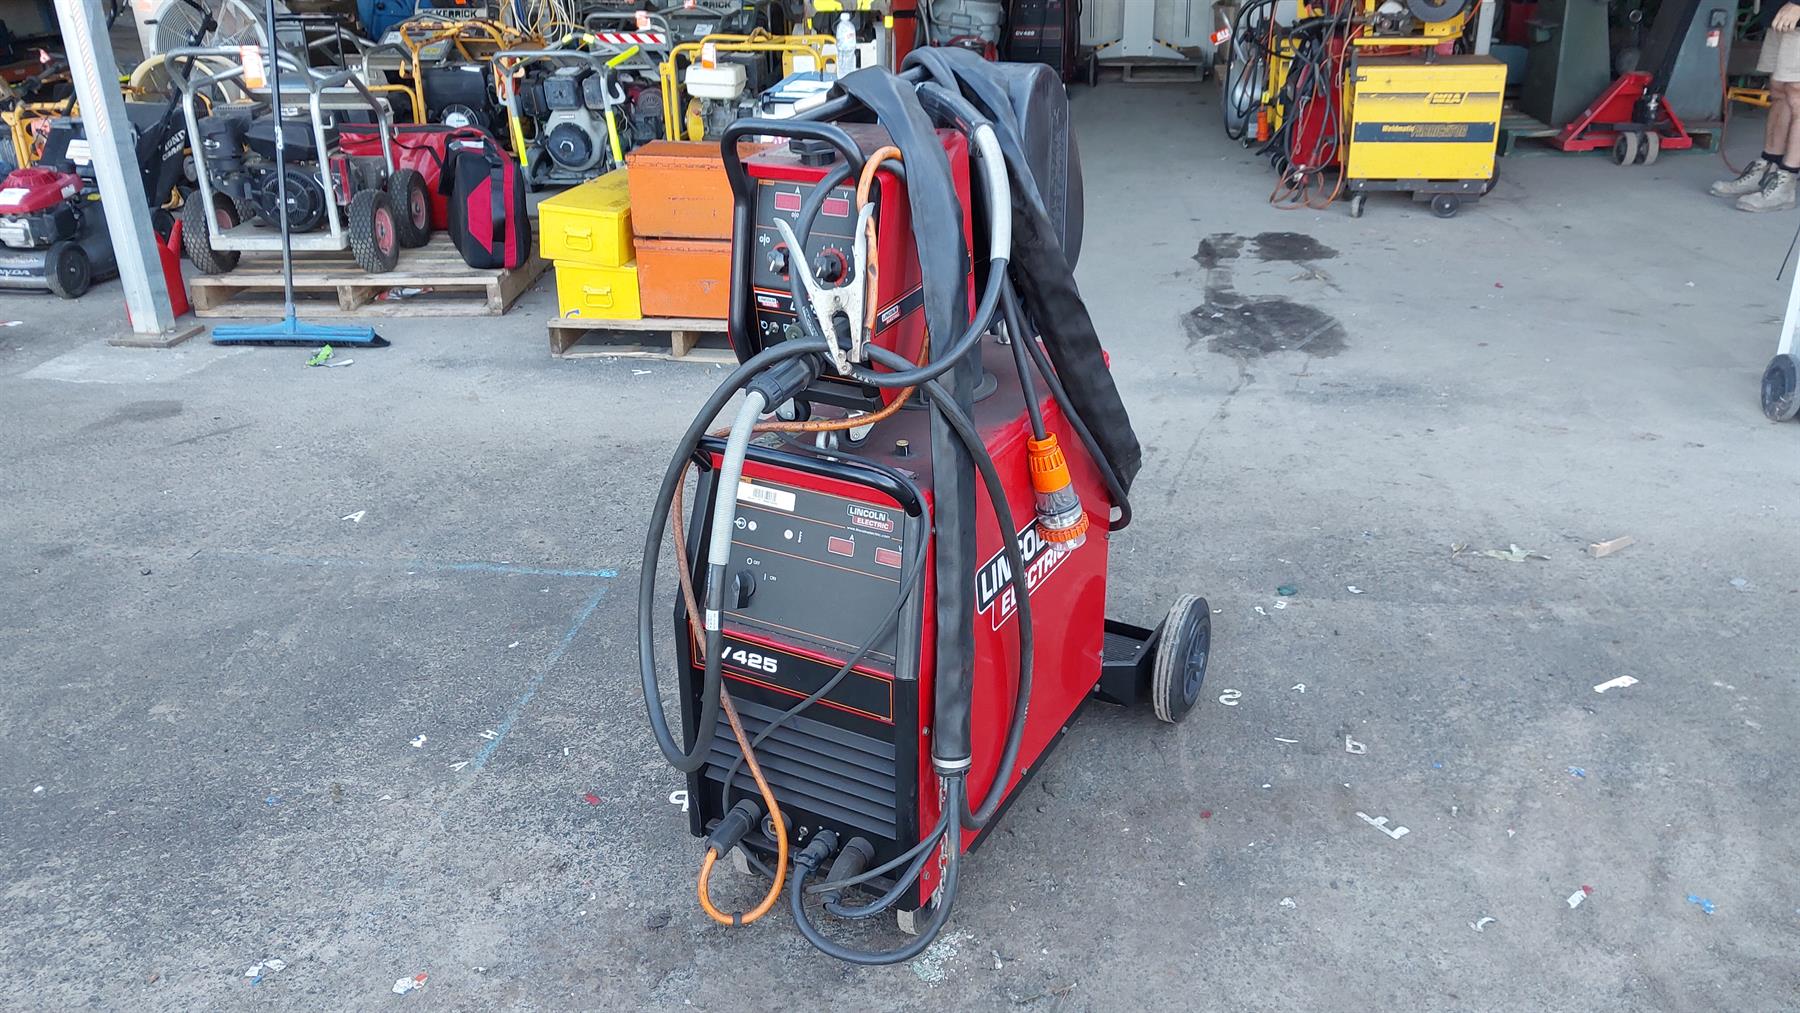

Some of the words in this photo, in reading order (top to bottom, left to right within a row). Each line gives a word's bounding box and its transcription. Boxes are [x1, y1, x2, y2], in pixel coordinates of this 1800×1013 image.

[849, 506, 886, 522] LINCOLN
[856, 517, 889, 530] ELECTRIC
[981, 527, 1049, 604] LINOL
[1001, 549, 1066, 617] ELCTRIC
